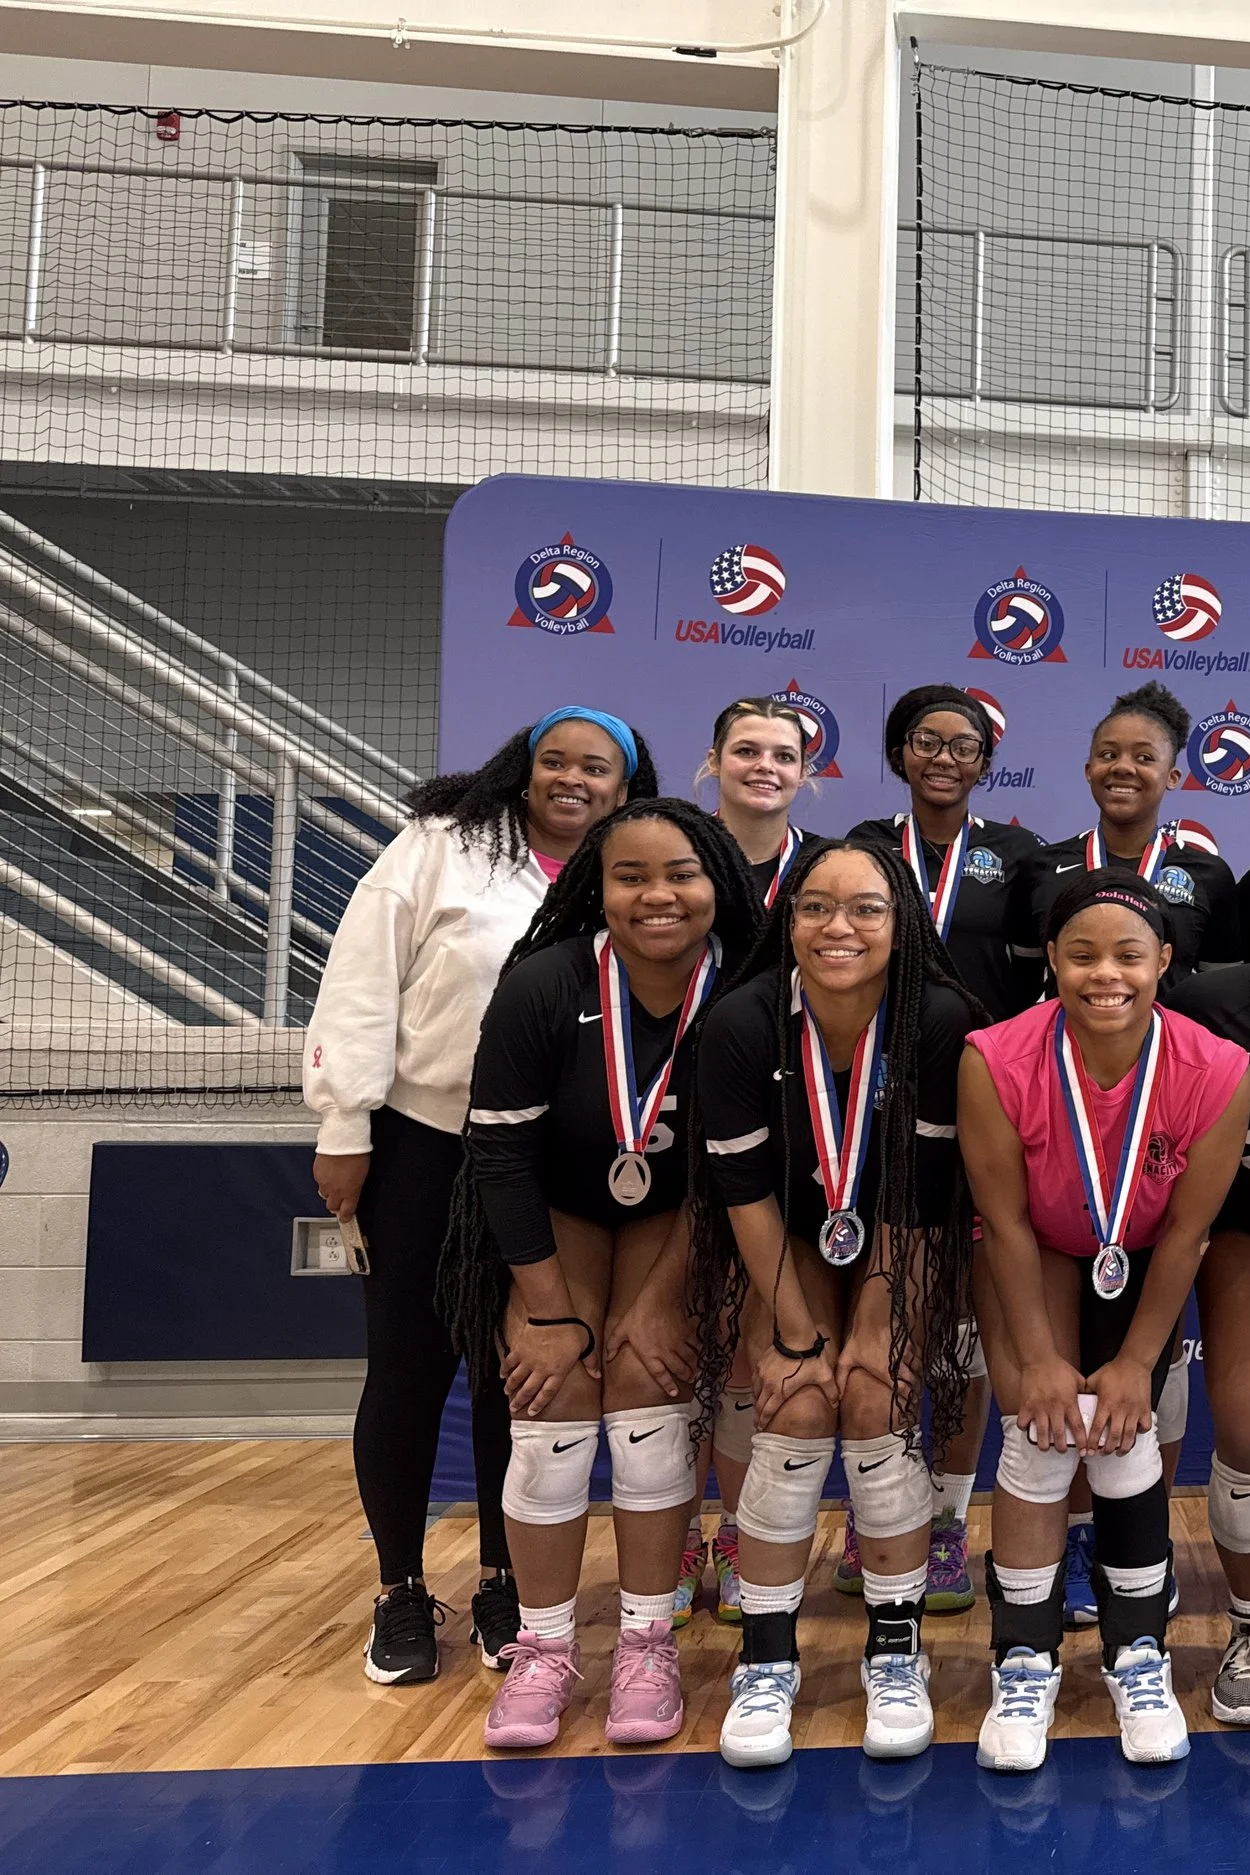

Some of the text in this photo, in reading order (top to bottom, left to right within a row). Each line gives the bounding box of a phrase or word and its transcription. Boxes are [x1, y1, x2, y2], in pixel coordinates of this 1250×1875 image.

[530, 544, 600, 569] Delta Region
[987, 578, 1052, 602] Delta Region
[533, 613, 590, 635] Volleyball
[993, 645, 1044, 665] Volleyball
[789, 691, 826, 715] Region
[1199, 713, 1226, 732] Delta
[961, 866, 1004, 878] TENACITY
